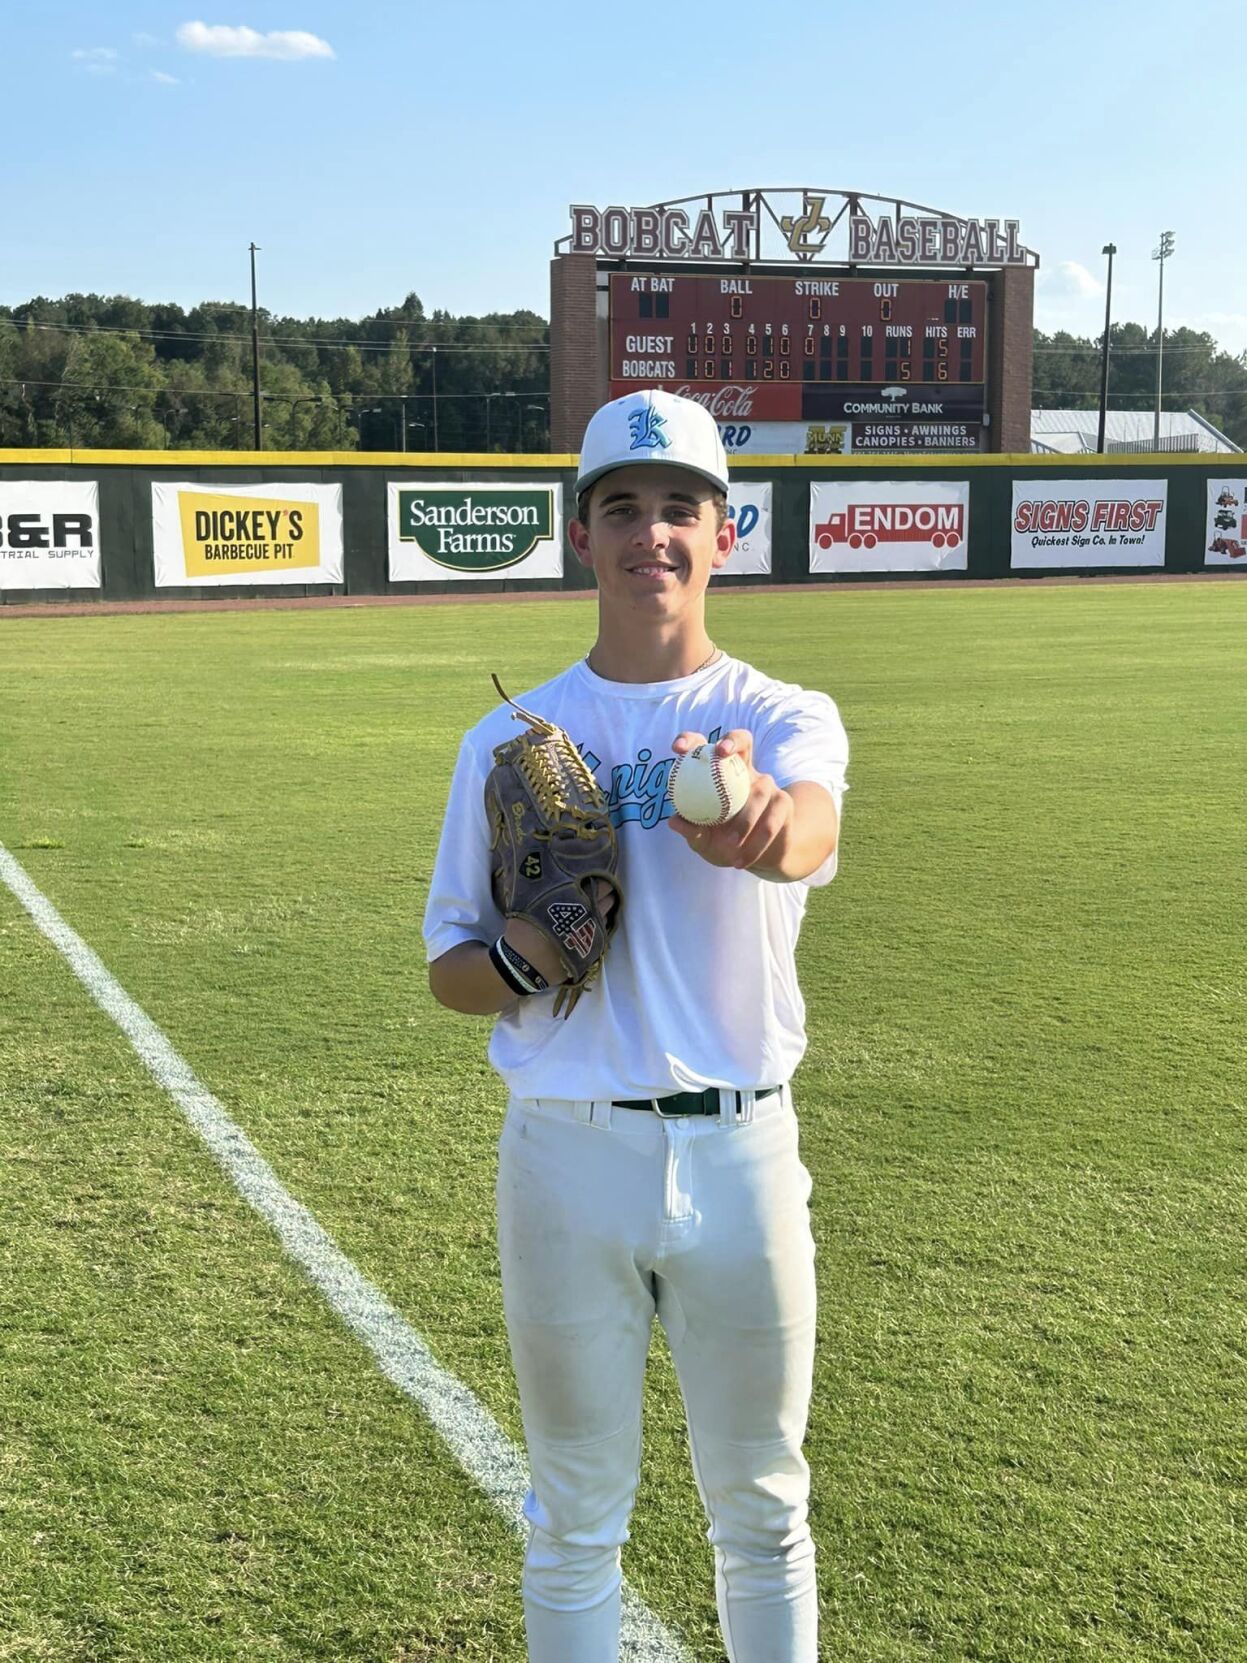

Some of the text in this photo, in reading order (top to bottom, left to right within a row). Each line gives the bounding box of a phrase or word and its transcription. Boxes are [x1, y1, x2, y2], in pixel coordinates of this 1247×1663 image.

[569, 204, 758, 258] BOBCAT
[850, 215, 1027, 265] BASEBALL
[631, 278, 675, 293] AT BAT
[720, 279, 753, 294] BALL
[795, 281, 839, 296] STRIKE
[873, 283, 899, 297] OUT
[948, 285, 969, 299] H/E
[690, 322, 977, 338] 1 2 3 4 5 6 7 8 9 10 RUNS HITS ERR
[625, 335, 674, 353] GUEST
[622, 360, 675, 379] BOBCATS
[843, 402, 944, 414] COMMUNITY BANK
[864, 425, 967, 436] SIGNS AWNINGS
[855, 436, 916, 447] CANOPIES
[924, 437, 976, 447] BANNERS
[410, 497, 539, 527] Sanderson
[854, 506, 959, 531] ENDOM
[1014, 500, 1164, 533] SIGNS FIRST
[0, 513, 93, 548] &R
[437, 527, 514, 554] Farms
[1031, 535, 1146, 548] Quickest Sign Co. In Town!
[48, 549, 94, 559] SUPPLY
[205, 543, 294, 560] BARBECUE PIT
[524, 854, 541, 878] 42
